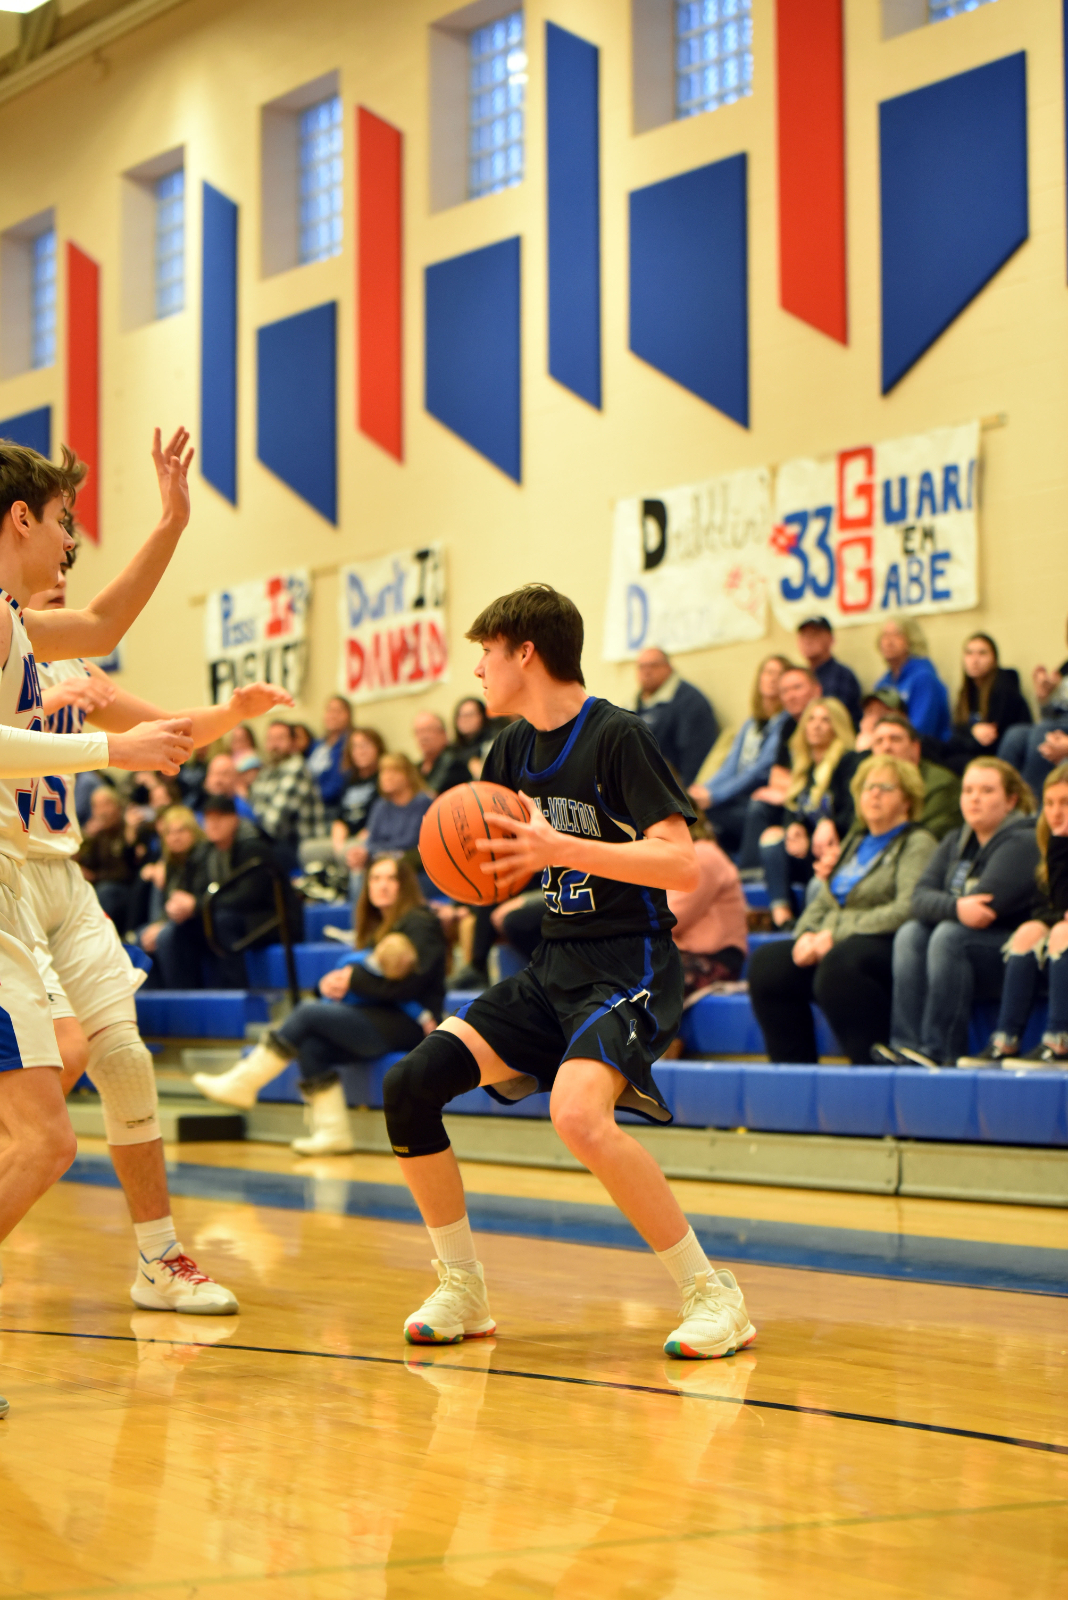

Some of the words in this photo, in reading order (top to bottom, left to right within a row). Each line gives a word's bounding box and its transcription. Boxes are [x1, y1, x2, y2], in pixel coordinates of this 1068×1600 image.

[837, 446, 976, 531] GUAR
[837, 536, 951, 614] GABE
[902, 526, 937, 555] EM
